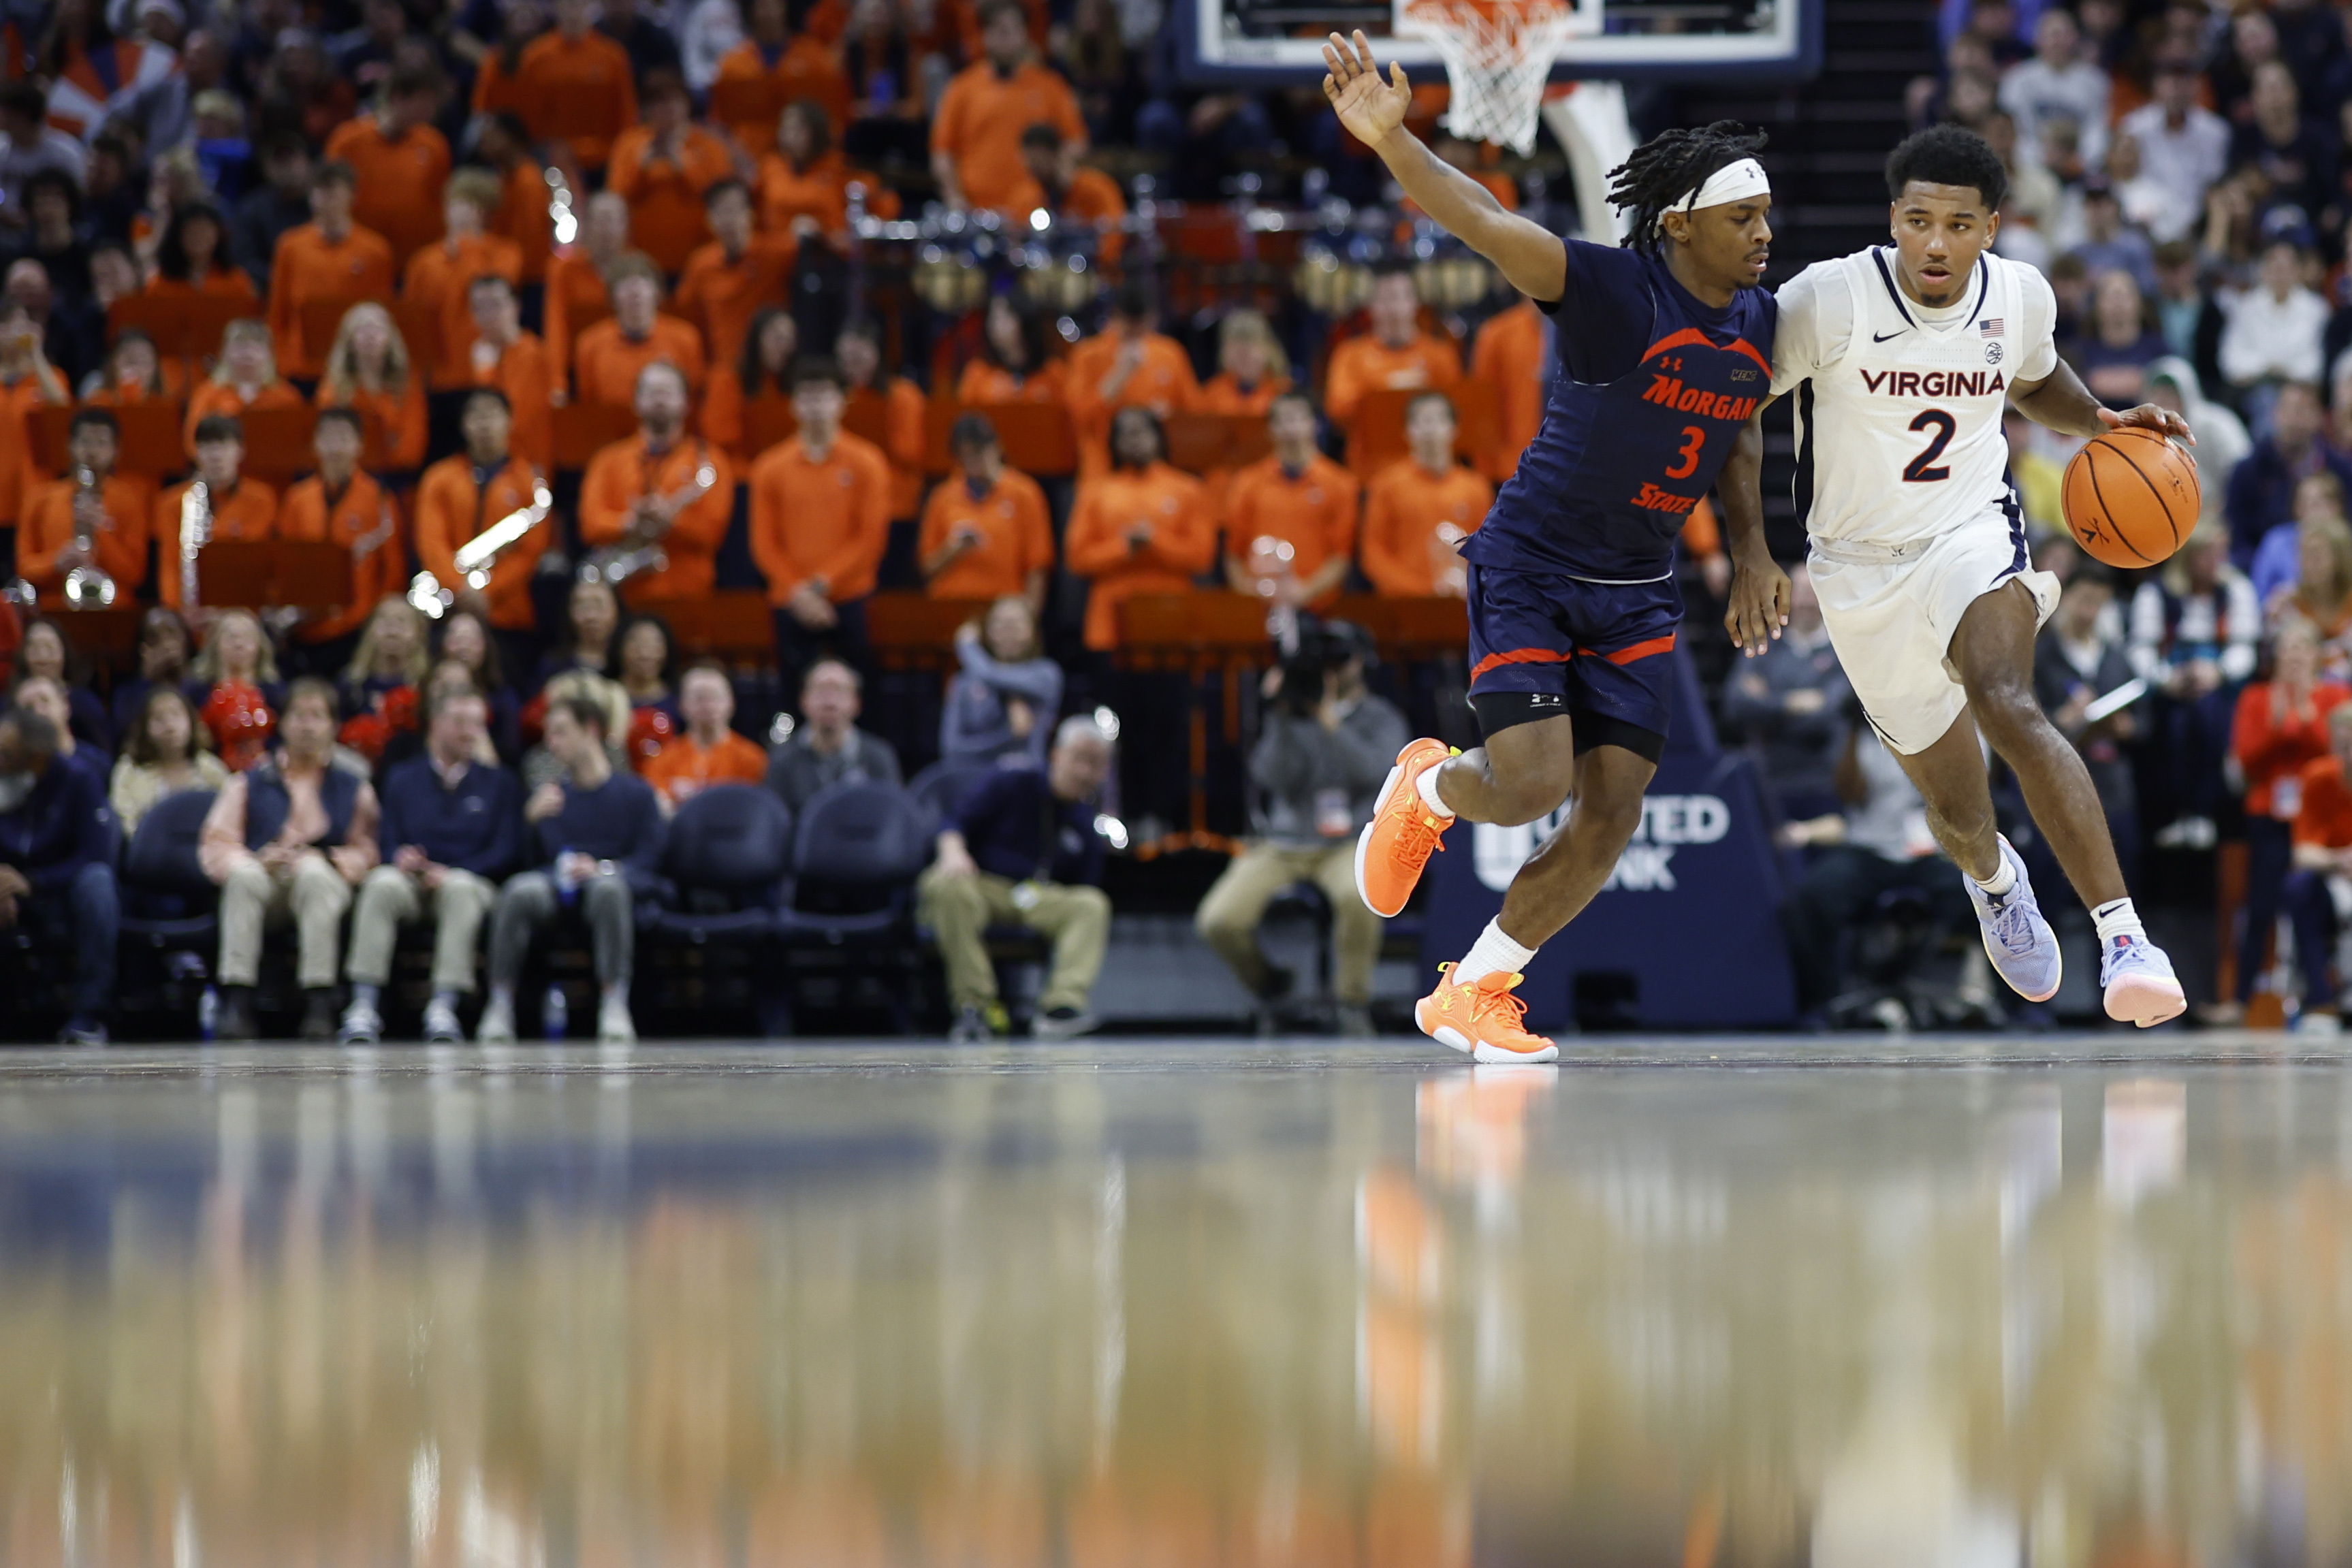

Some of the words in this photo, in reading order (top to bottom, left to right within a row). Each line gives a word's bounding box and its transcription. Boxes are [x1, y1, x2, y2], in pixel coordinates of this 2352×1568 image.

[1642, 374, 1758, 420] MORGAN
[1859, 368, 2005, 397] VIRGINIA
[1665, 426, 1706, 479] 3
[1902, 409, 1956, 482] 2
[1630, 481, 1697, 514] STATE
